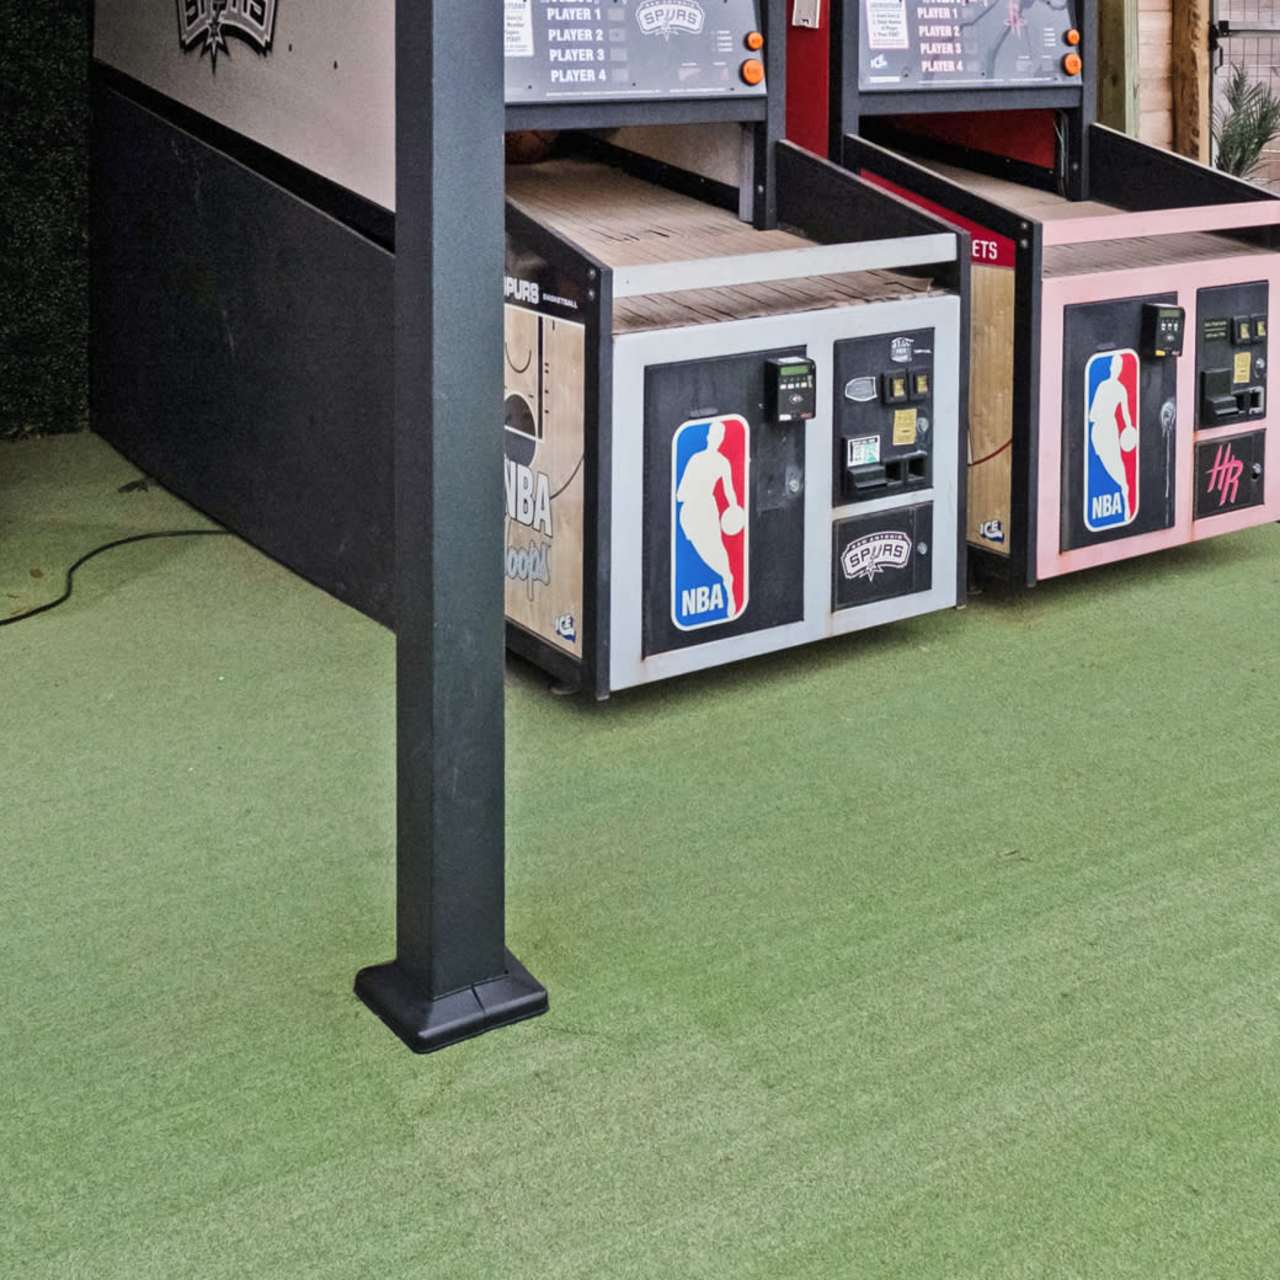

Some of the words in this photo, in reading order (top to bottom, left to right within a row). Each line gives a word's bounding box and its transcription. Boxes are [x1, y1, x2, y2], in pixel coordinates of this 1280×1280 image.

[547, 8, 592, 20] PLAYER
[595, 8, 601, 20] 1
[643, 8, 698, 25] SPURS
[917, 7, 951, 19] PLAYER
[952, 8, 958, 19] 1
[548, 29, 593, 41] PLAYER
[595, 29, 603, 41] 2
[918, 26, 952, 37] PLAYER
[953, 26, 960, 37] 2
[549, 49, 594, 61] PLAYER
[596, 49, 605, 61] 3
[920, 43, 953, 55] PLAYER
[954, 43, 962, 54] 3
[921, 60, 955, 72] PLAYER
[956, 61, 963, 72] 4
[550, 69, 595, 82] PLAYER
[598, 69, 607, 81] 4
[1092, 492, 1122, 520] NBA
[980, 519, 1000, 538] ICE
[849, 543, 904, 569] SPURS
[681, 583, 724, 617] NBA
